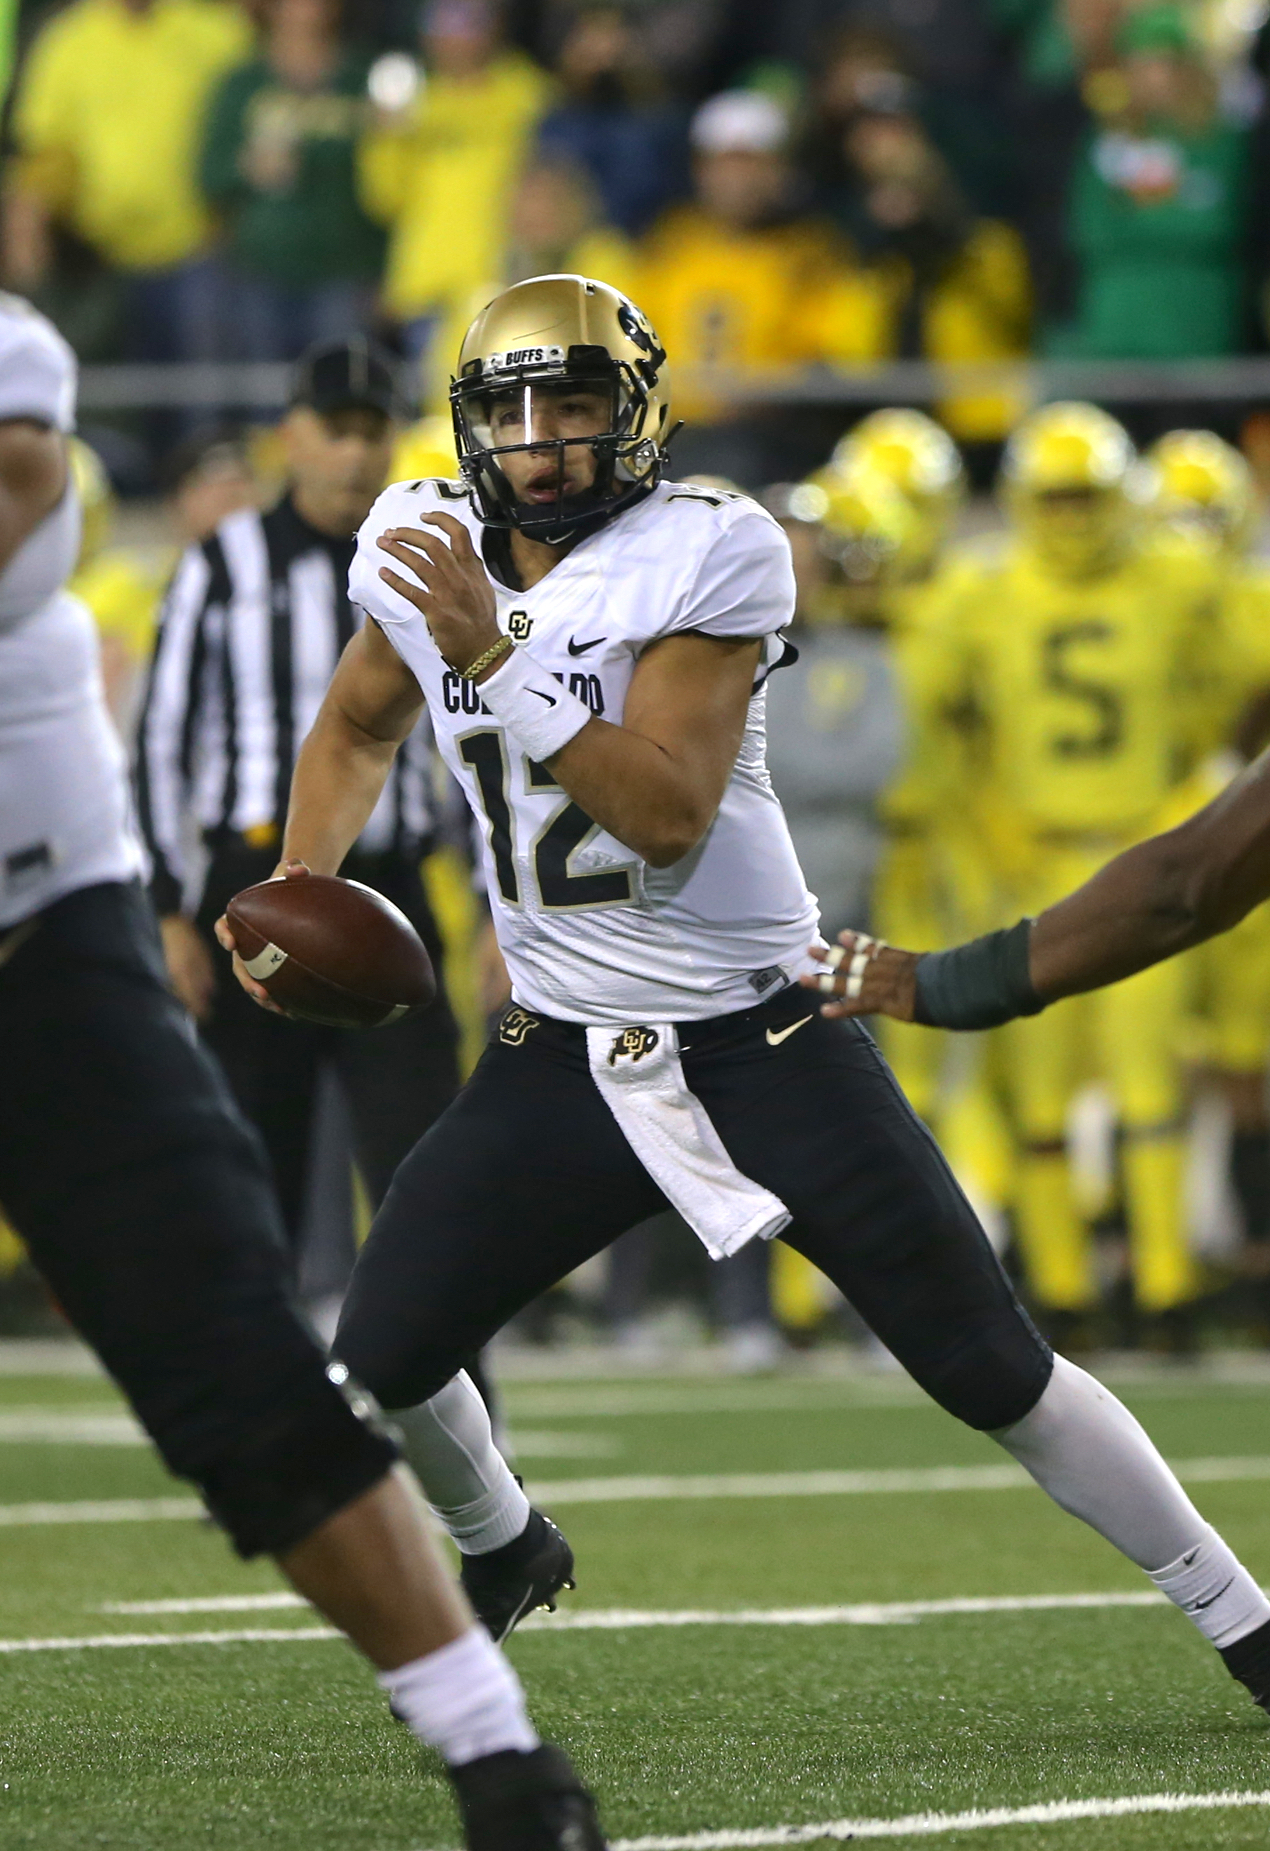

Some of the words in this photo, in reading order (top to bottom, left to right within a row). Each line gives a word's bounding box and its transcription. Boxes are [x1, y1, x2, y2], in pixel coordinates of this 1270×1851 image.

[506, 348, 544, 366] BUFFS
[508, 610, 534, 640] CU
[1042, 620, 1124, 760] 5
[454, 725, 642, 914] 12
